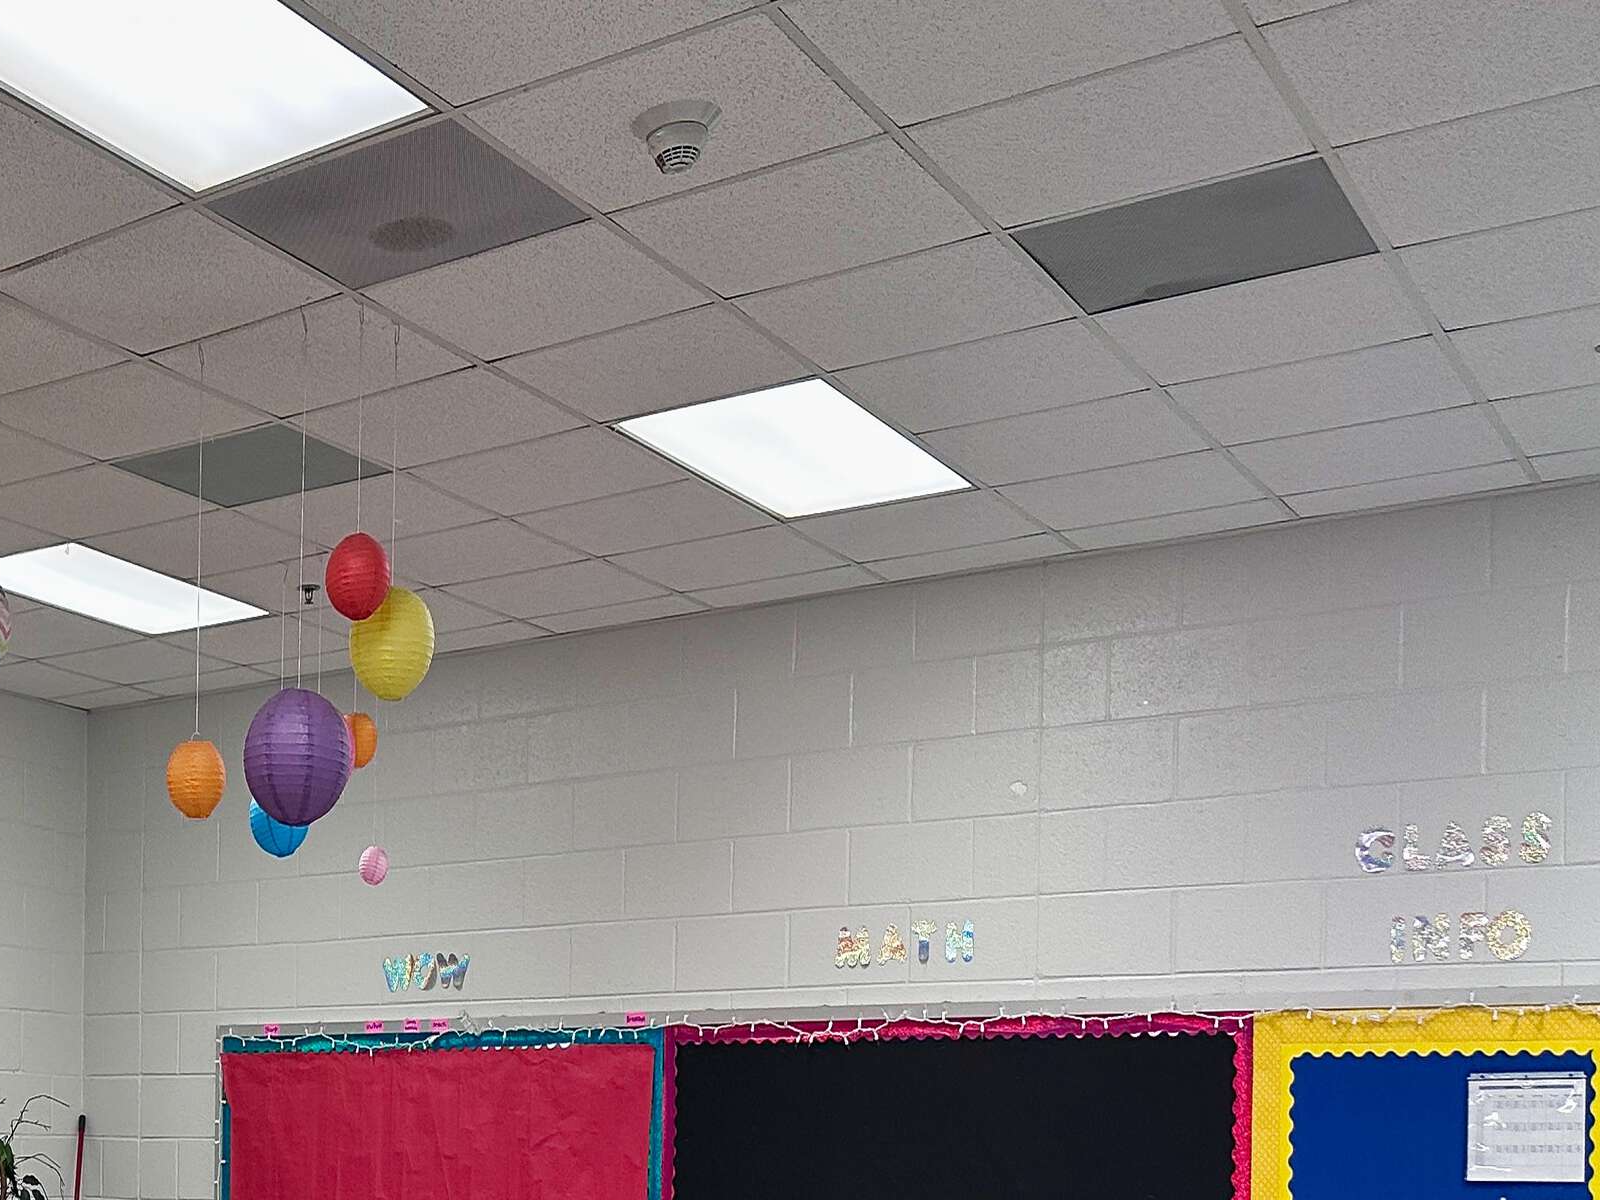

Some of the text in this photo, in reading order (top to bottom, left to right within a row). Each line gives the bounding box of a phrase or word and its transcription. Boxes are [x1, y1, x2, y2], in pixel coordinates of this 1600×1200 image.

[1355, 811, 1552, 873] CLASS
[834, 919, 975, 968] MATH
[1389, 909, 1532, 963] INFO
[382, 951, 471, 993] WOW
